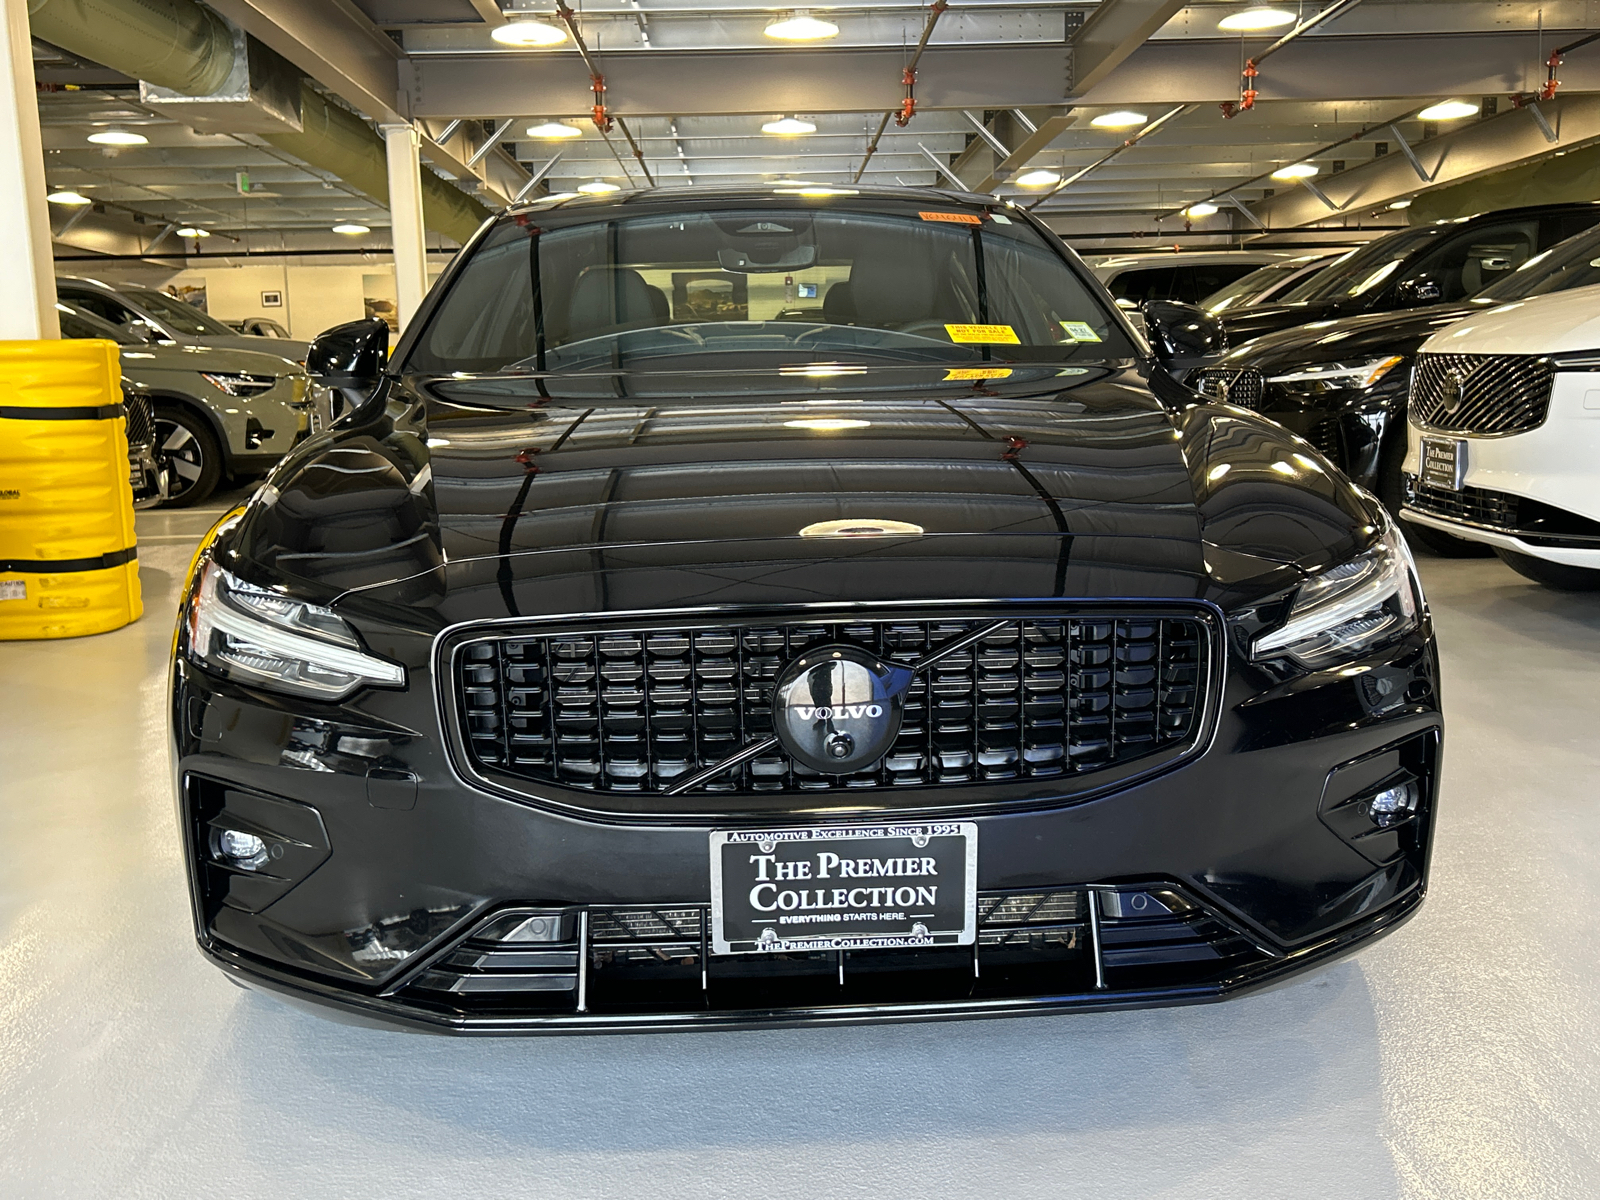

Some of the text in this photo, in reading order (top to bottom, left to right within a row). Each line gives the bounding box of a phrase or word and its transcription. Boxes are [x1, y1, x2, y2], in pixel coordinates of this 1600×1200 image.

[1425, 457, 1454, 472] COLLECTION
[794, 705, 883, 720] VOLVO
[729, 824, 959, 842] AUTOMOTIVE EXCELLENCE SINCE 1995
[749, 852, 938, 882] THE PREMIER
[749, 883, 938, 912] COLLECTION
[779, 912, 907, 925] EVERYTHING STARTS HERE.
[754, 936, 934, 950] THEPREMIERCOLLECTION.COM
